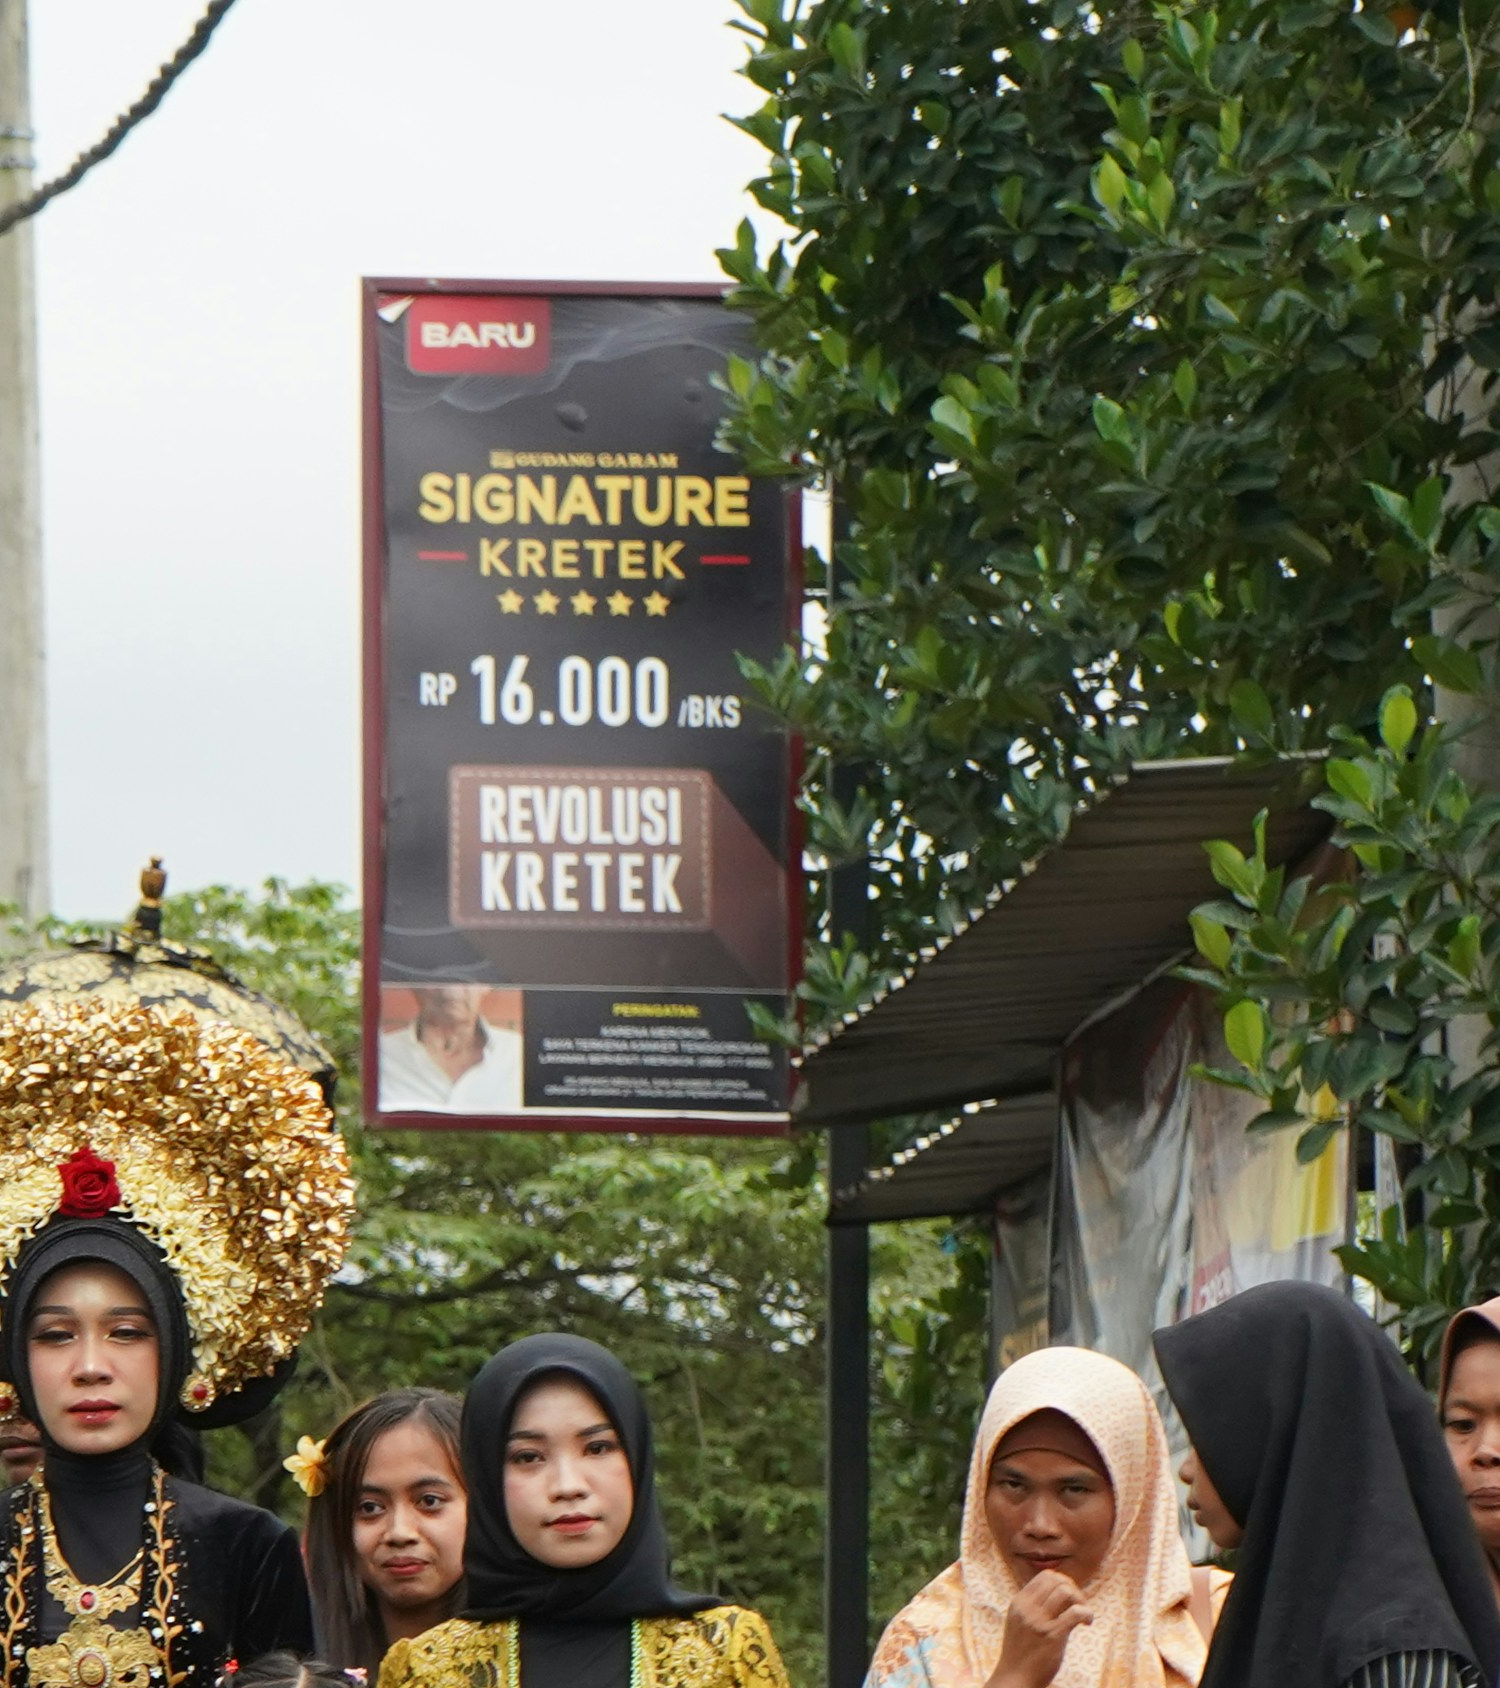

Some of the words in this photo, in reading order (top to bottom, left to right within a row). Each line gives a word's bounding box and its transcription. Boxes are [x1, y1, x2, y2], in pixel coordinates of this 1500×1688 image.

[420, 322, 536, 349] BARU
[514, 451, 597, 468] GUDANG
[597, 451, 679, 469] GARAM
[418, 472, 751, 527] SIGNATURE
[479, 537, 687, 580] KRETEK
[419, 672, 457, 706] RP
[470, 654, 670, 728] 16.000
[676, 694, 742, 729] /BKS
[478, 784, 683, 846] REVOLUSI
[480, 851, 683, 913] KRETEK
